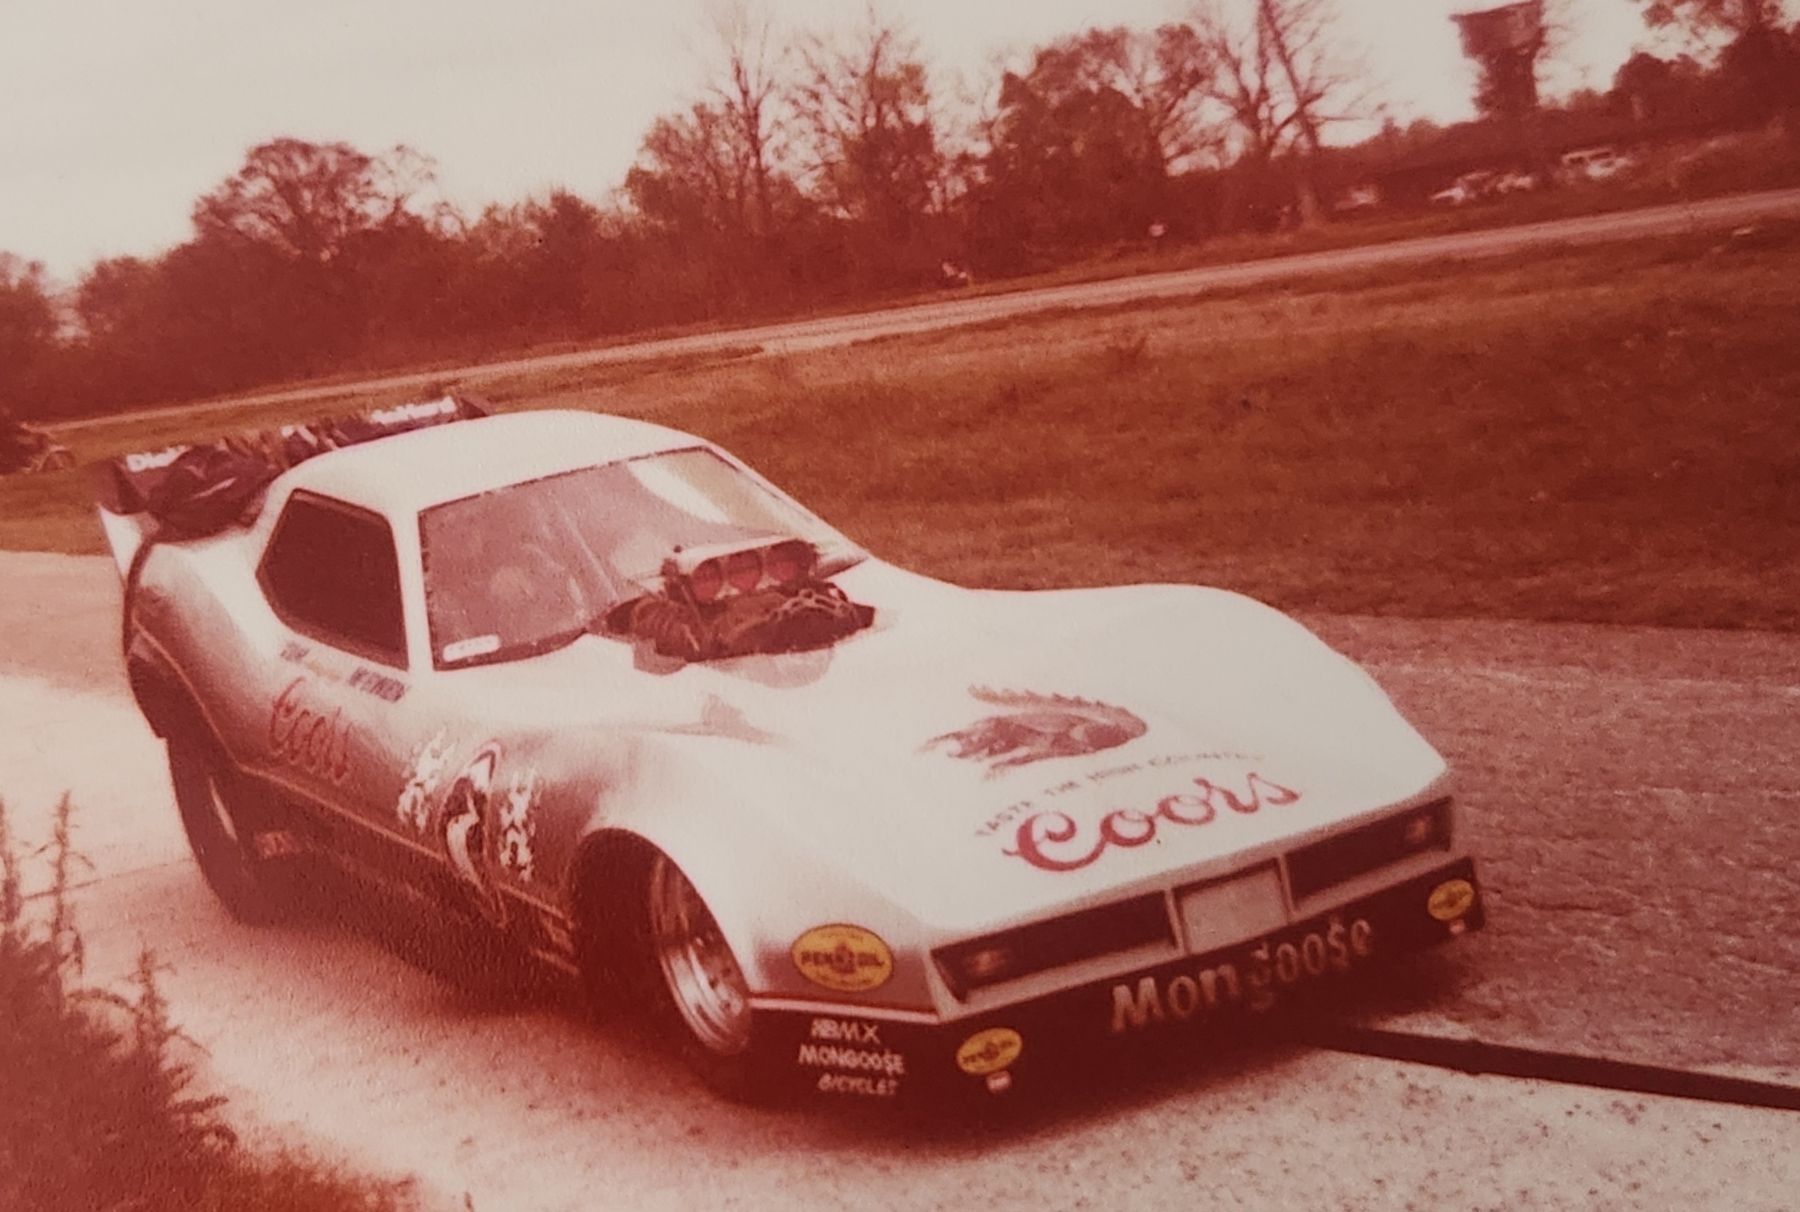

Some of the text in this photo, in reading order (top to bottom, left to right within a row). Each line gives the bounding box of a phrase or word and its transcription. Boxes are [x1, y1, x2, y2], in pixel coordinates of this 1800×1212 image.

[1001, 770, 1301, 872] Coors
[1111, 917, 1372, 1033] Mongoose
[798, 1044, 905, 1076] MONGOOSE
